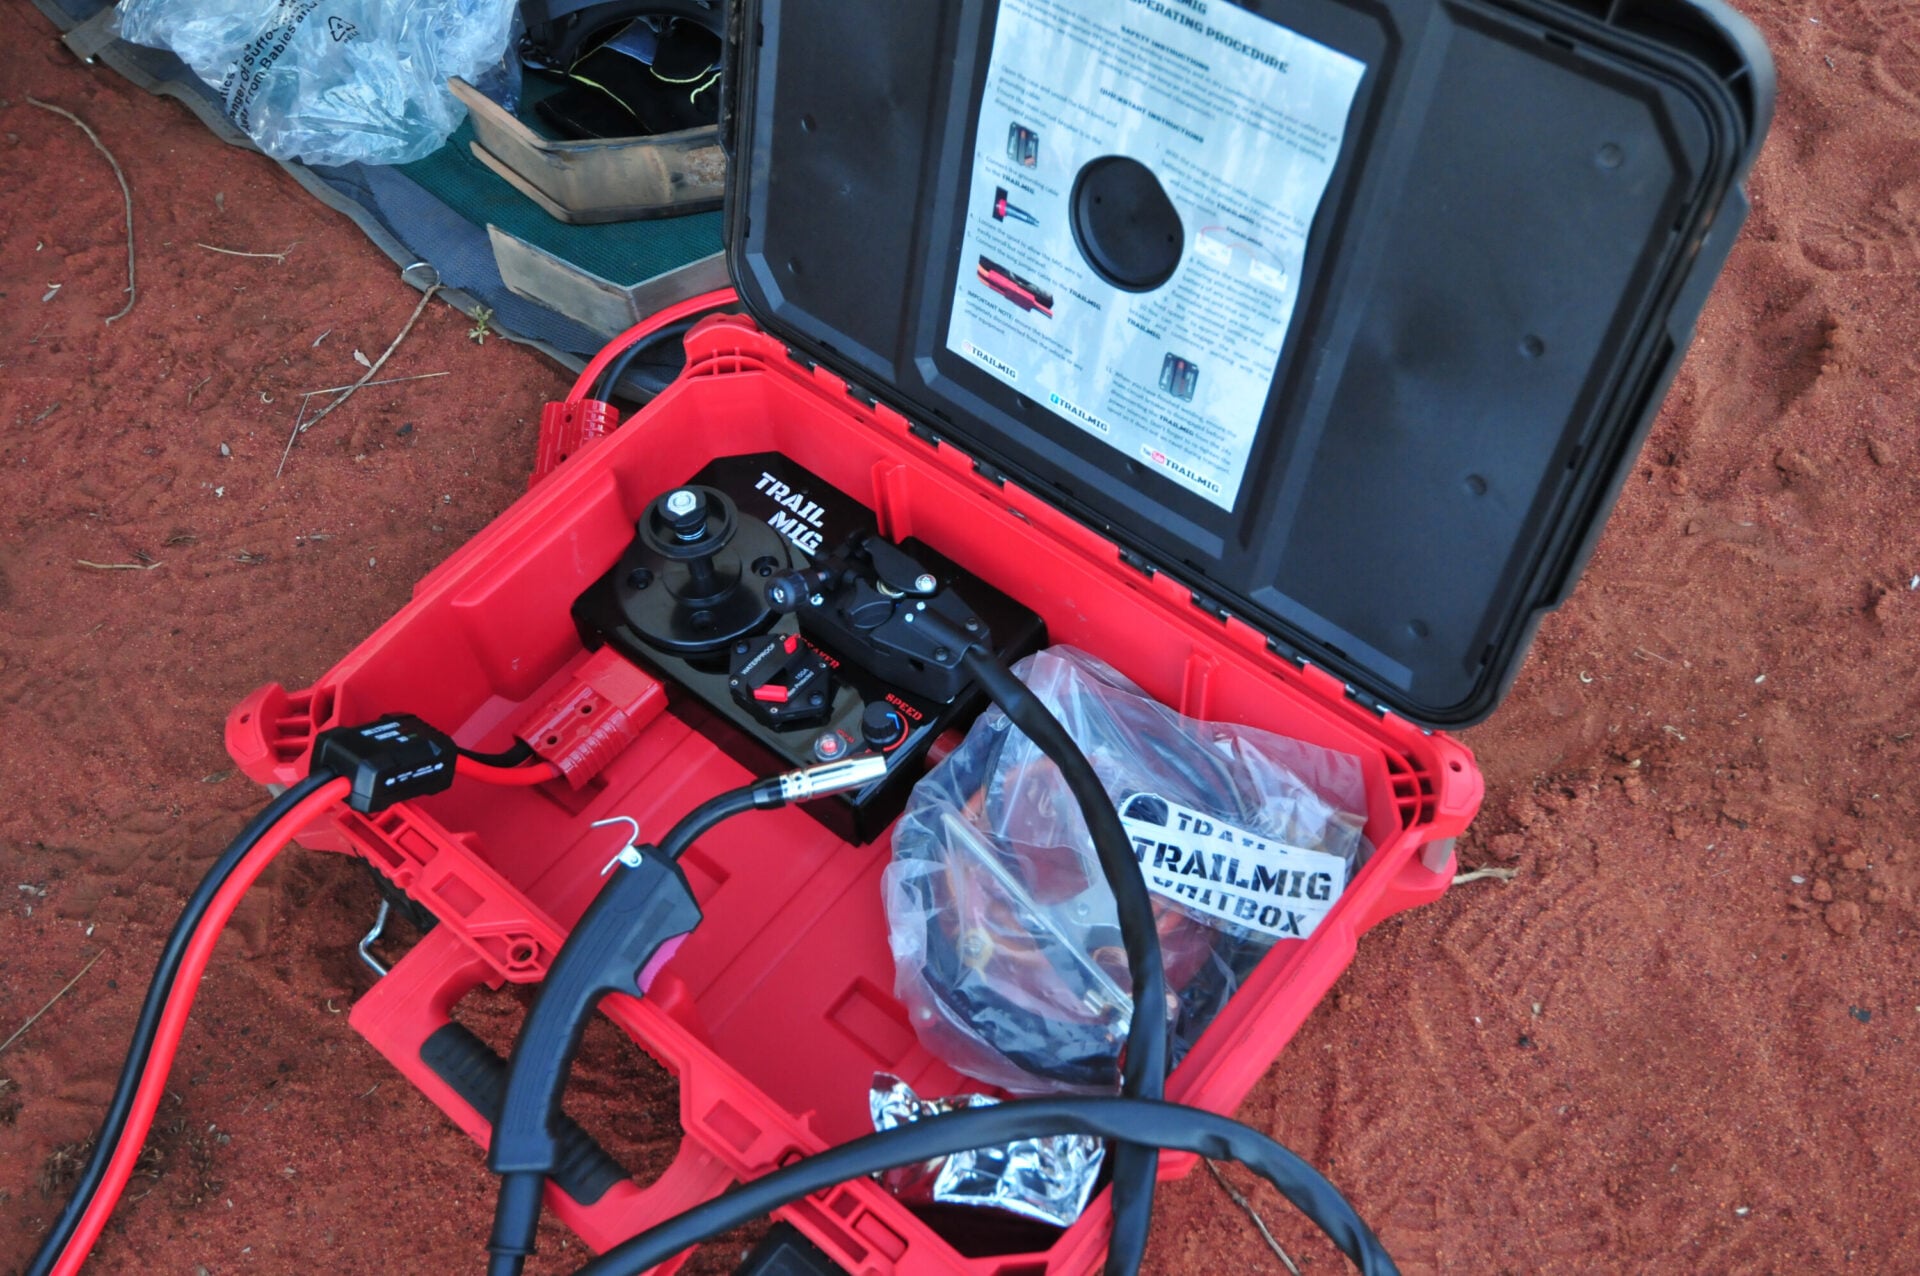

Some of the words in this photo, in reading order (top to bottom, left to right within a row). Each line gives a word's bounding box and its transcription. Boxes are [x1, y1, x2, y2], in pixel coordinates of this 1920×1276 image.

[259, 24, 297, 71] Babies
[1206, 27, 1289, 73] PROCEDURE
[969, 346, 1017, 379] TRAILMIG
[1058, 398, 1109, 432] TRAILMIG
[1163, 458, 1220, 493] TRAILMIG
[754, 472, 827, 527] TRAIL
[768, 510, 823, 552] MIG
[741, 643, 775, 675] WATERPROOF
[885, 693, 924, 721] SPEED
[1132, 834, 1332, 902] TRAILMIG
